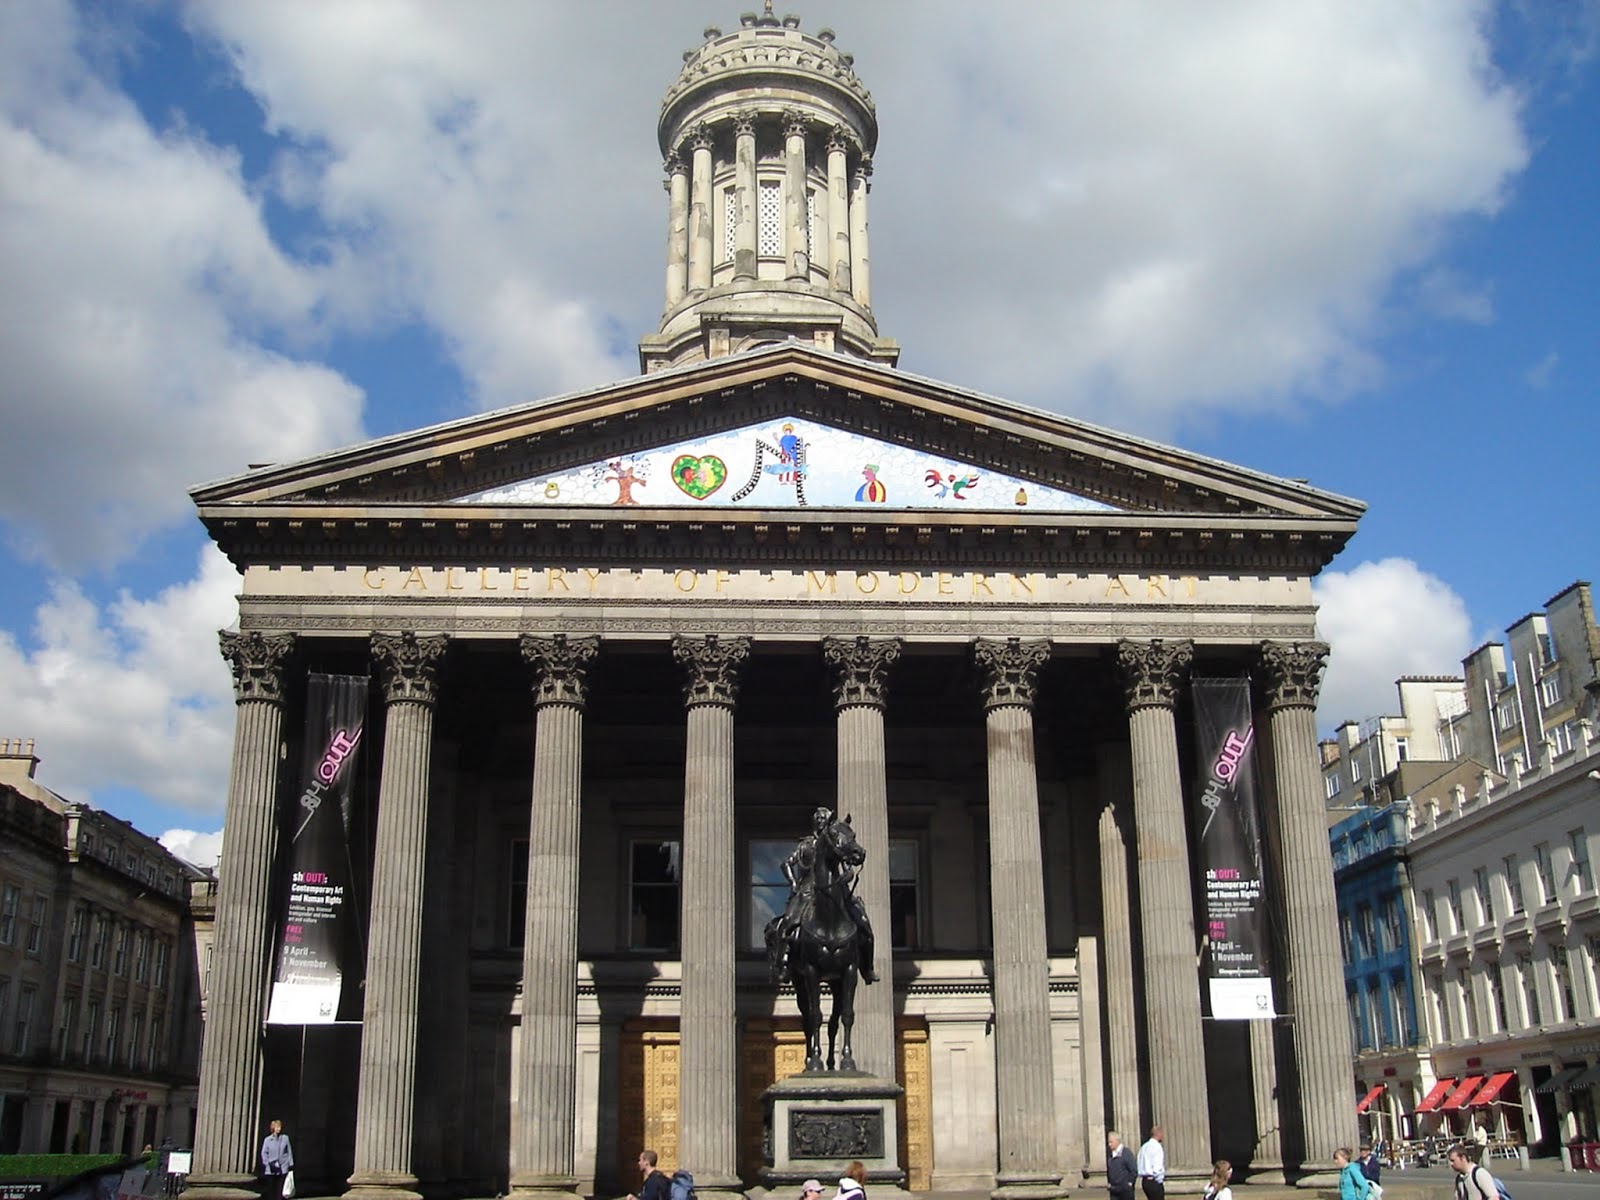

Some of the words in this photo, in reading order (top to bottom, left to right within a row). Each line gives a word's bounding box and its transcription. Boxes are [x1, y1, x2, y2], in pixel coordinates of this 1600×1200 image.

[363, 566, 601, 591] GALLERY
[673, 569, 735, 593] OF
[806, 570, 1035, 596] MODERN
[1105, 574, 1202, 597] ART
[1209, 921, 1225, 930] FREE
[284, 945, 290, 955] 9
[290, 946, 309, 957] April
[1210, 941, 1216, 951] 9
[1217, 941, 1234, 952] April
[1218, 952, 1254, 962] November
[289, 957, 328, 969] November
